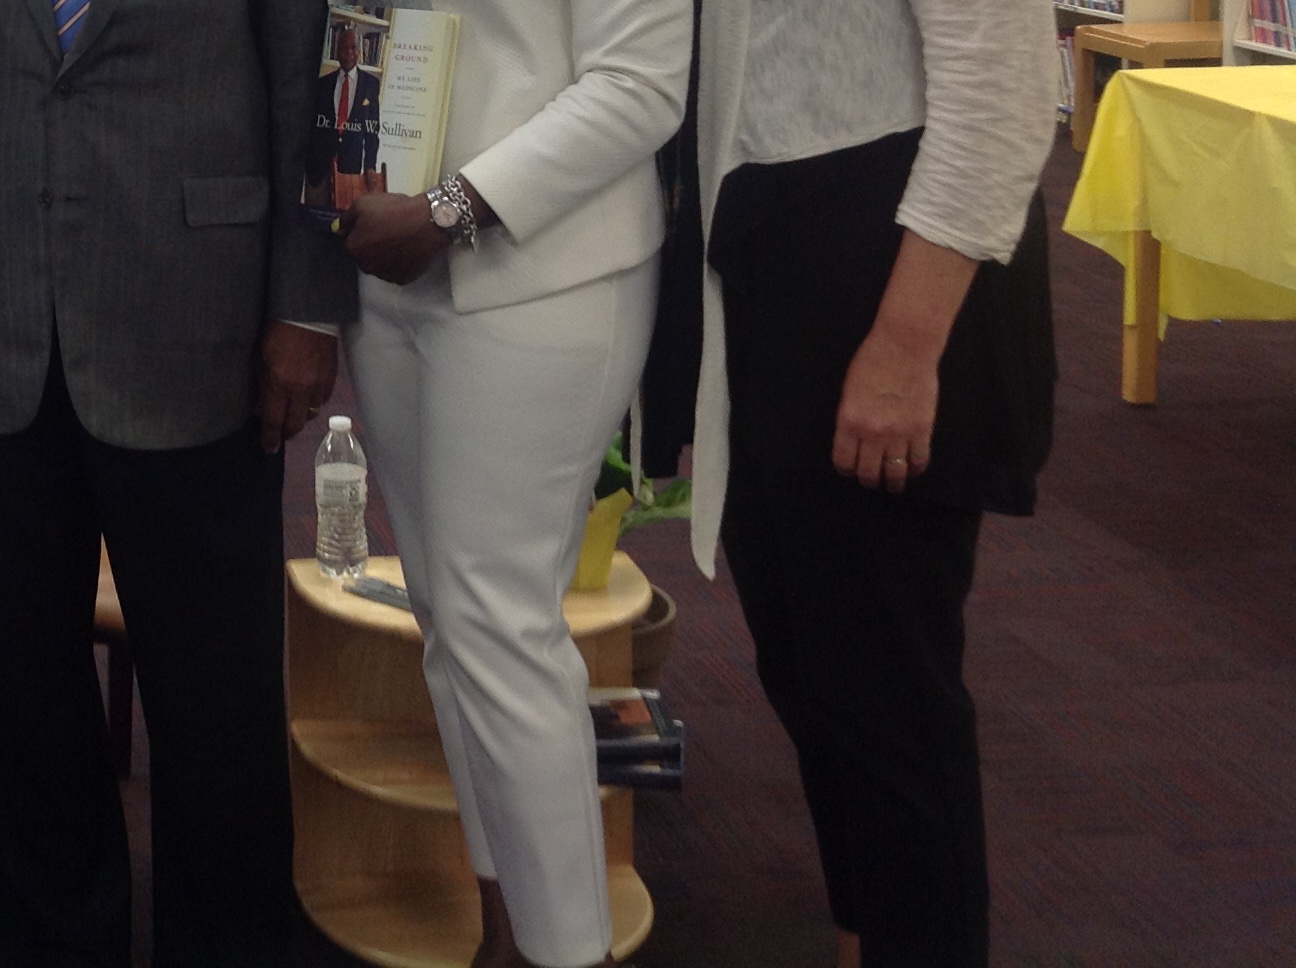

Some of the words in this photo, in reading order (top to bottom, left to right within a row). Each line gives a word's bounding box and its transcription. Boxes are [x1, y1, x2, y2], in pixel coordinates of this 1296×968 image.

[316, 114, 331, 129] Dr.
[334, 117, 362, 132] Louis
[364, 119, 378, 135] W.
[381, 121, 422, 139] Sullivan
